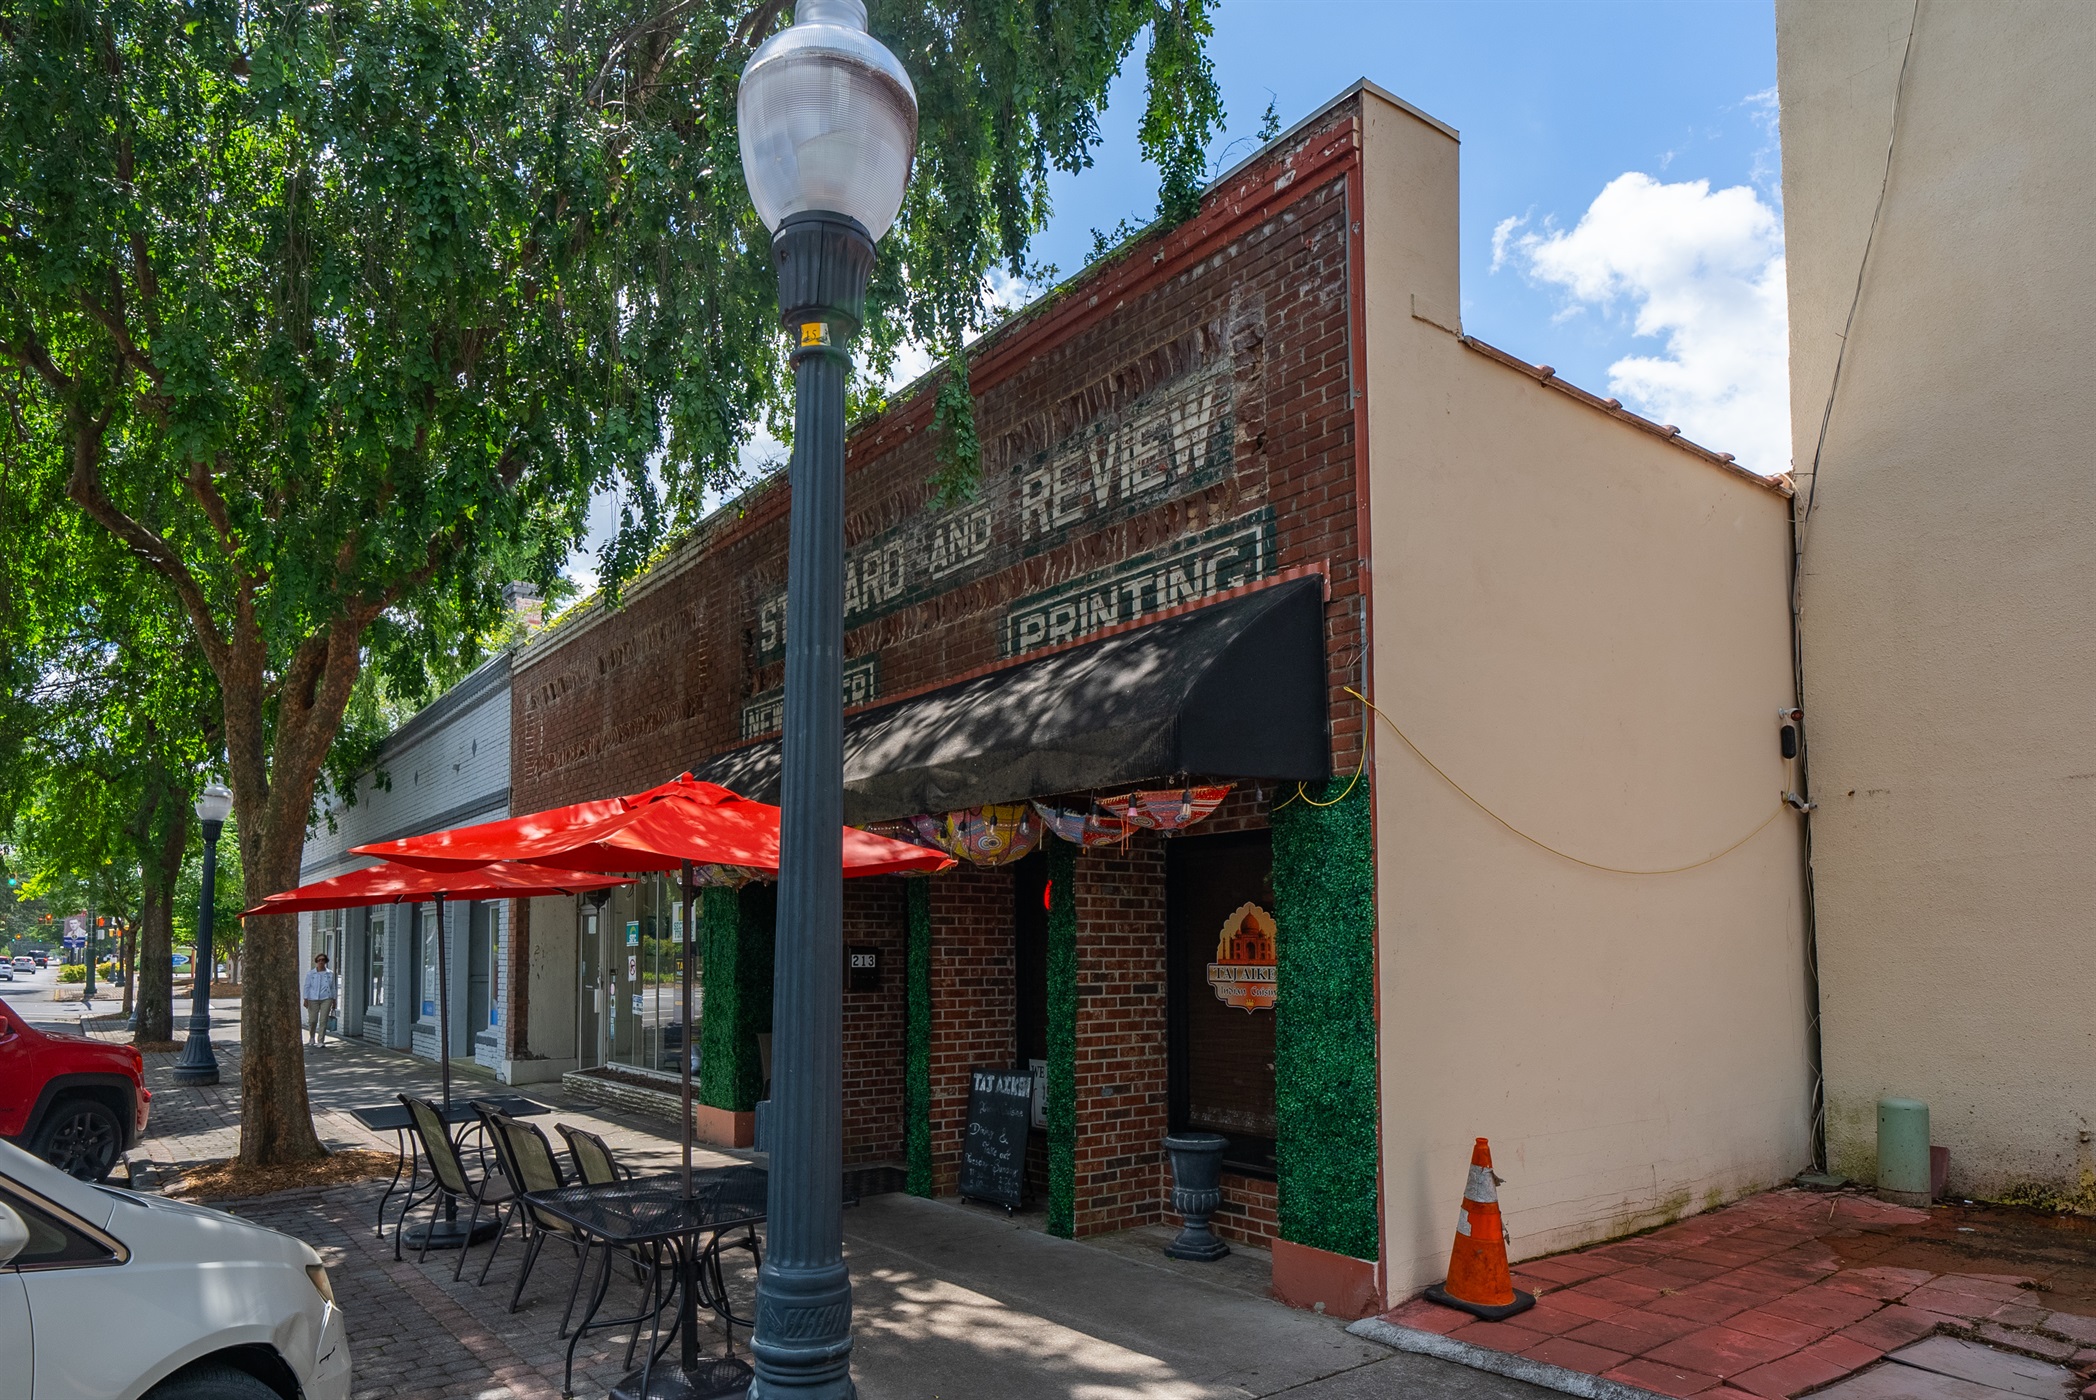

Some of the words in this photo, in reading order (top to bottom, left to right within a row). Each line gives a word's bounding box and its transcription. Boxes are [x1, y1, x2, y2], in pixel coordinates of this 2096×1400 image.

[929, 507, 991, 573] AND
[1021, 384, 1213, 541] REVIEW
[1020, 546, 1244, 655] PRINTING
[852, 955, 875, 967] 213
[1213, 967, 1237, 982] TAJ
[1241, 967, 1277, 980] AIKE
[1250, 985, 1277, 997] Cuisin
[973, 1072, 995, 1093] TAJ
